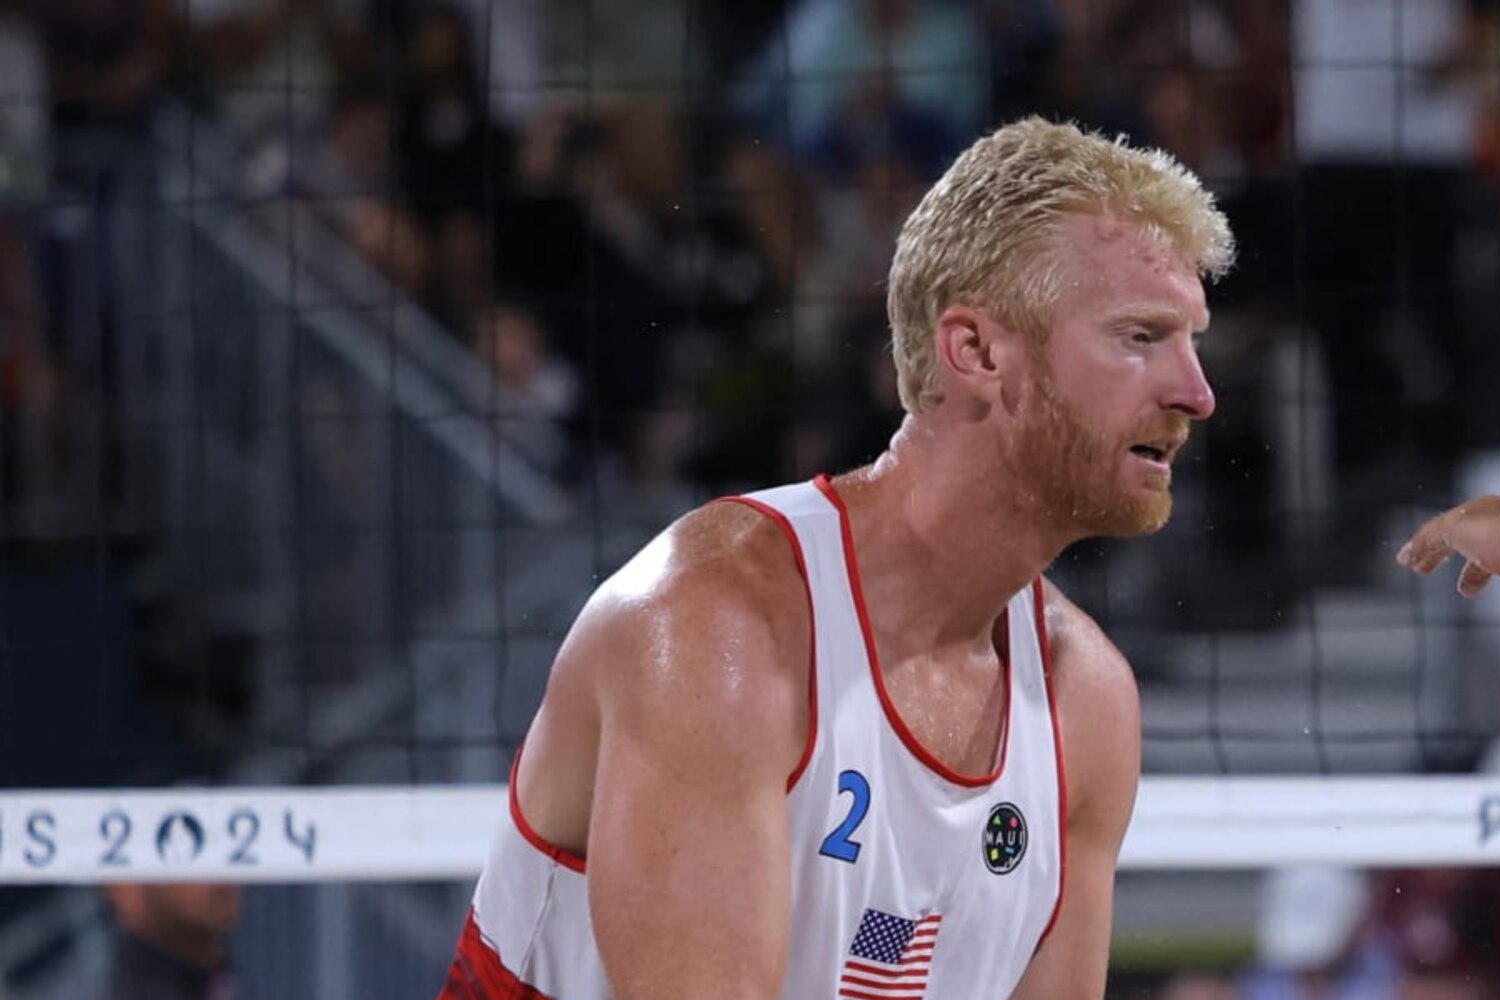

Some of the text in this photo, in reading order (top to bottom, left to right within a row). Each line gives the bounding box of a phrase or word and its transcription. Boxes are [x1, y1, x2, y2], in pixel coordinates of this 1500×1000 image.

[0, 806, 316, 868] S 2024
[819, 769, 871, 864] 2
[985, 830, 1025, 845] MAUI
